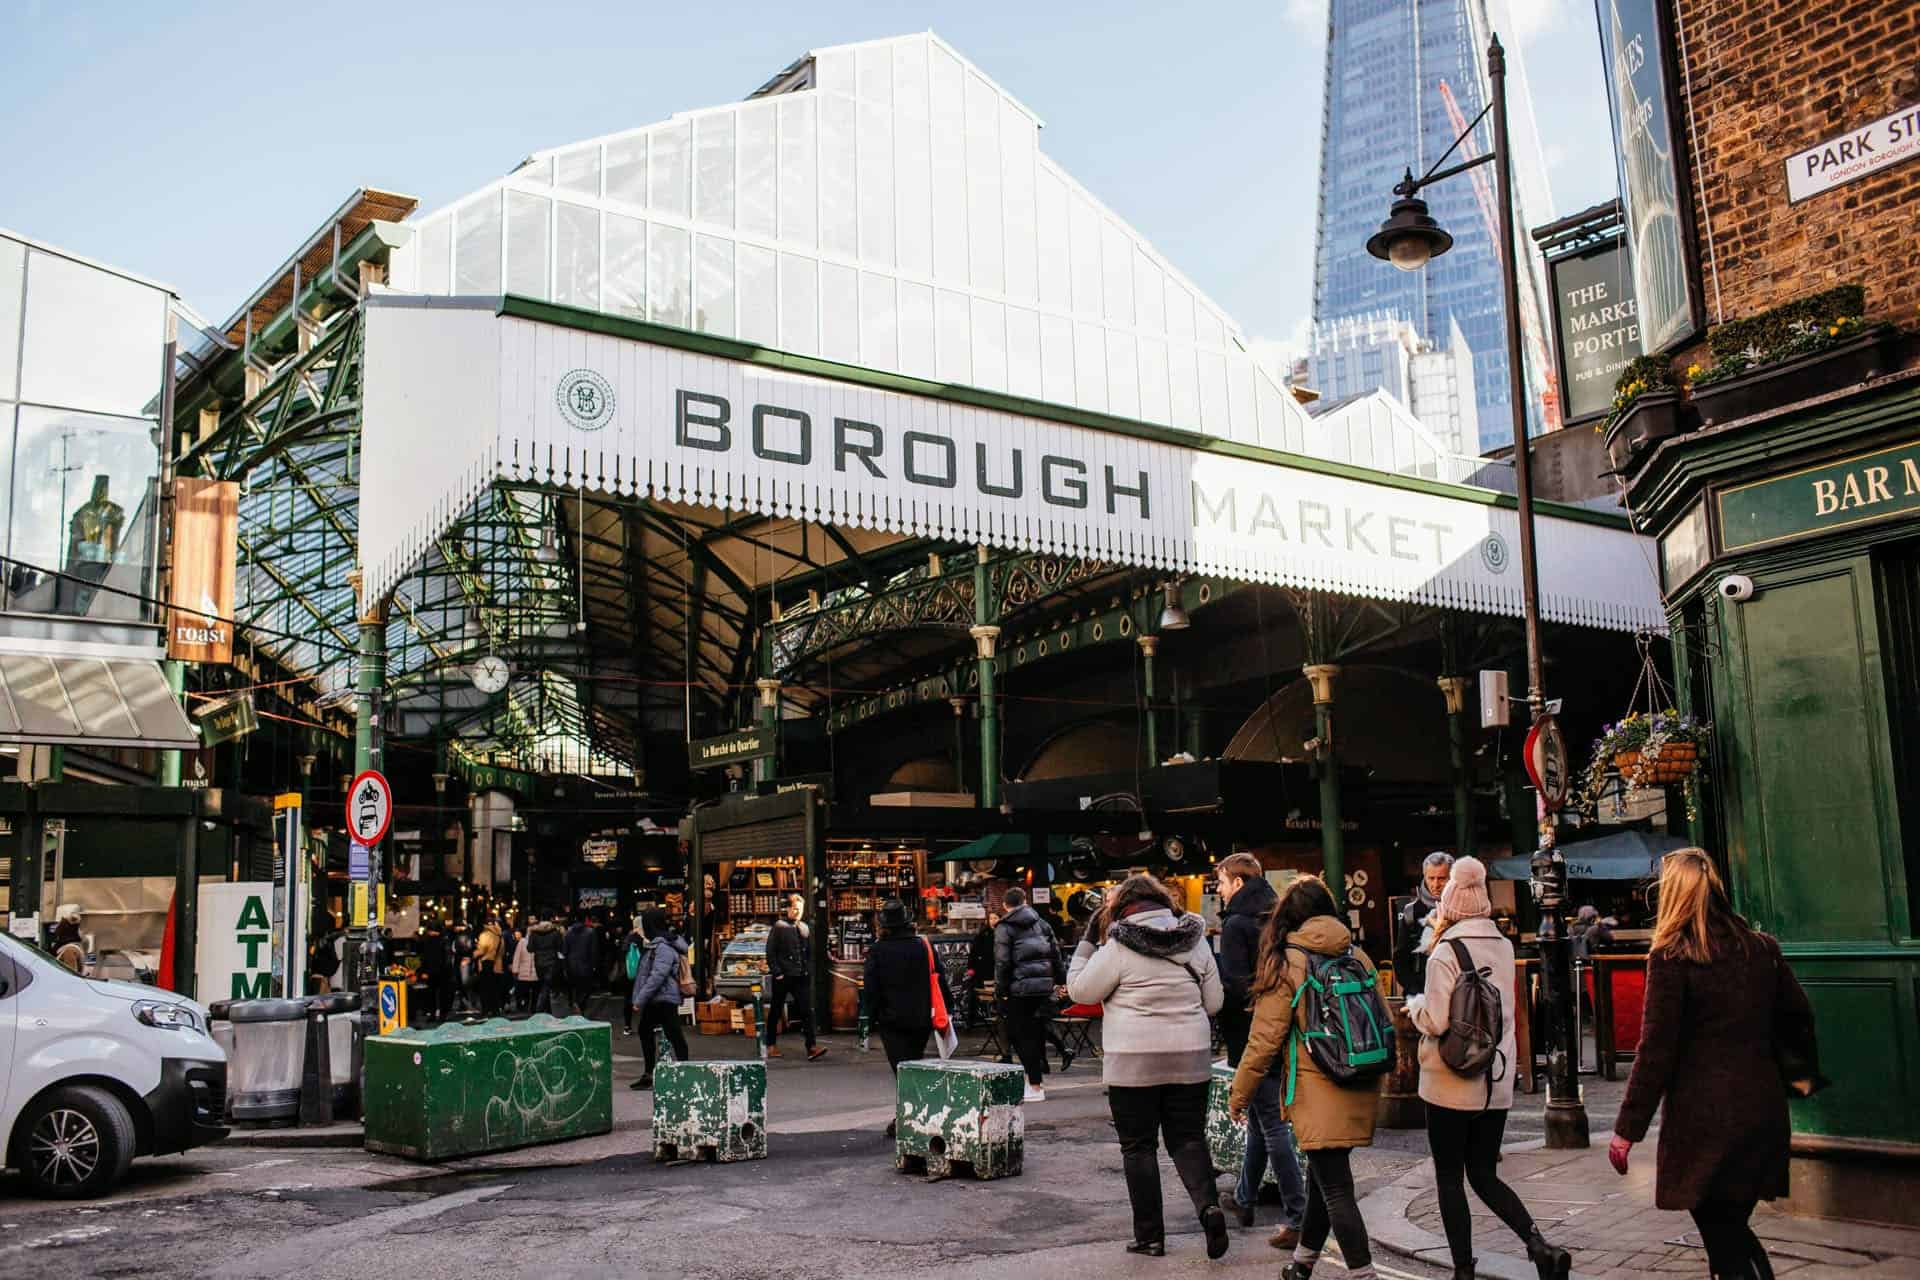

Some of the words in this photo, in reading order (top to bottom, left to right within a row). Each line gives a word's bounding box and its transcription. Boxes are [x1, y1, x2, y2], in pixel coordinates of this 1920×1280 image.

[1806, 130, 1875, 177] PARK
[1887, 111, 1920, 143] ST
[1829, 162, 1866, 181] LONDON
[1869, 143, 1913, 166] BOROUGH
[1567, 282, 1608, 308] THE
[1570, 299, 1639, 334] MARKE
[1573, 324, 1640, 359] PORTE
[1575, 370, 1593, 382] PUB
[675, 388, 1150, 520] BOROUGH
[1191, 479, 1453, 566] MARKET
[1811, 466, 1895, 516] BAR
[176, 626, 226, 644] roast
[182, 776, 209, 788] roast
[231, 895, 273, 1000] ATM
